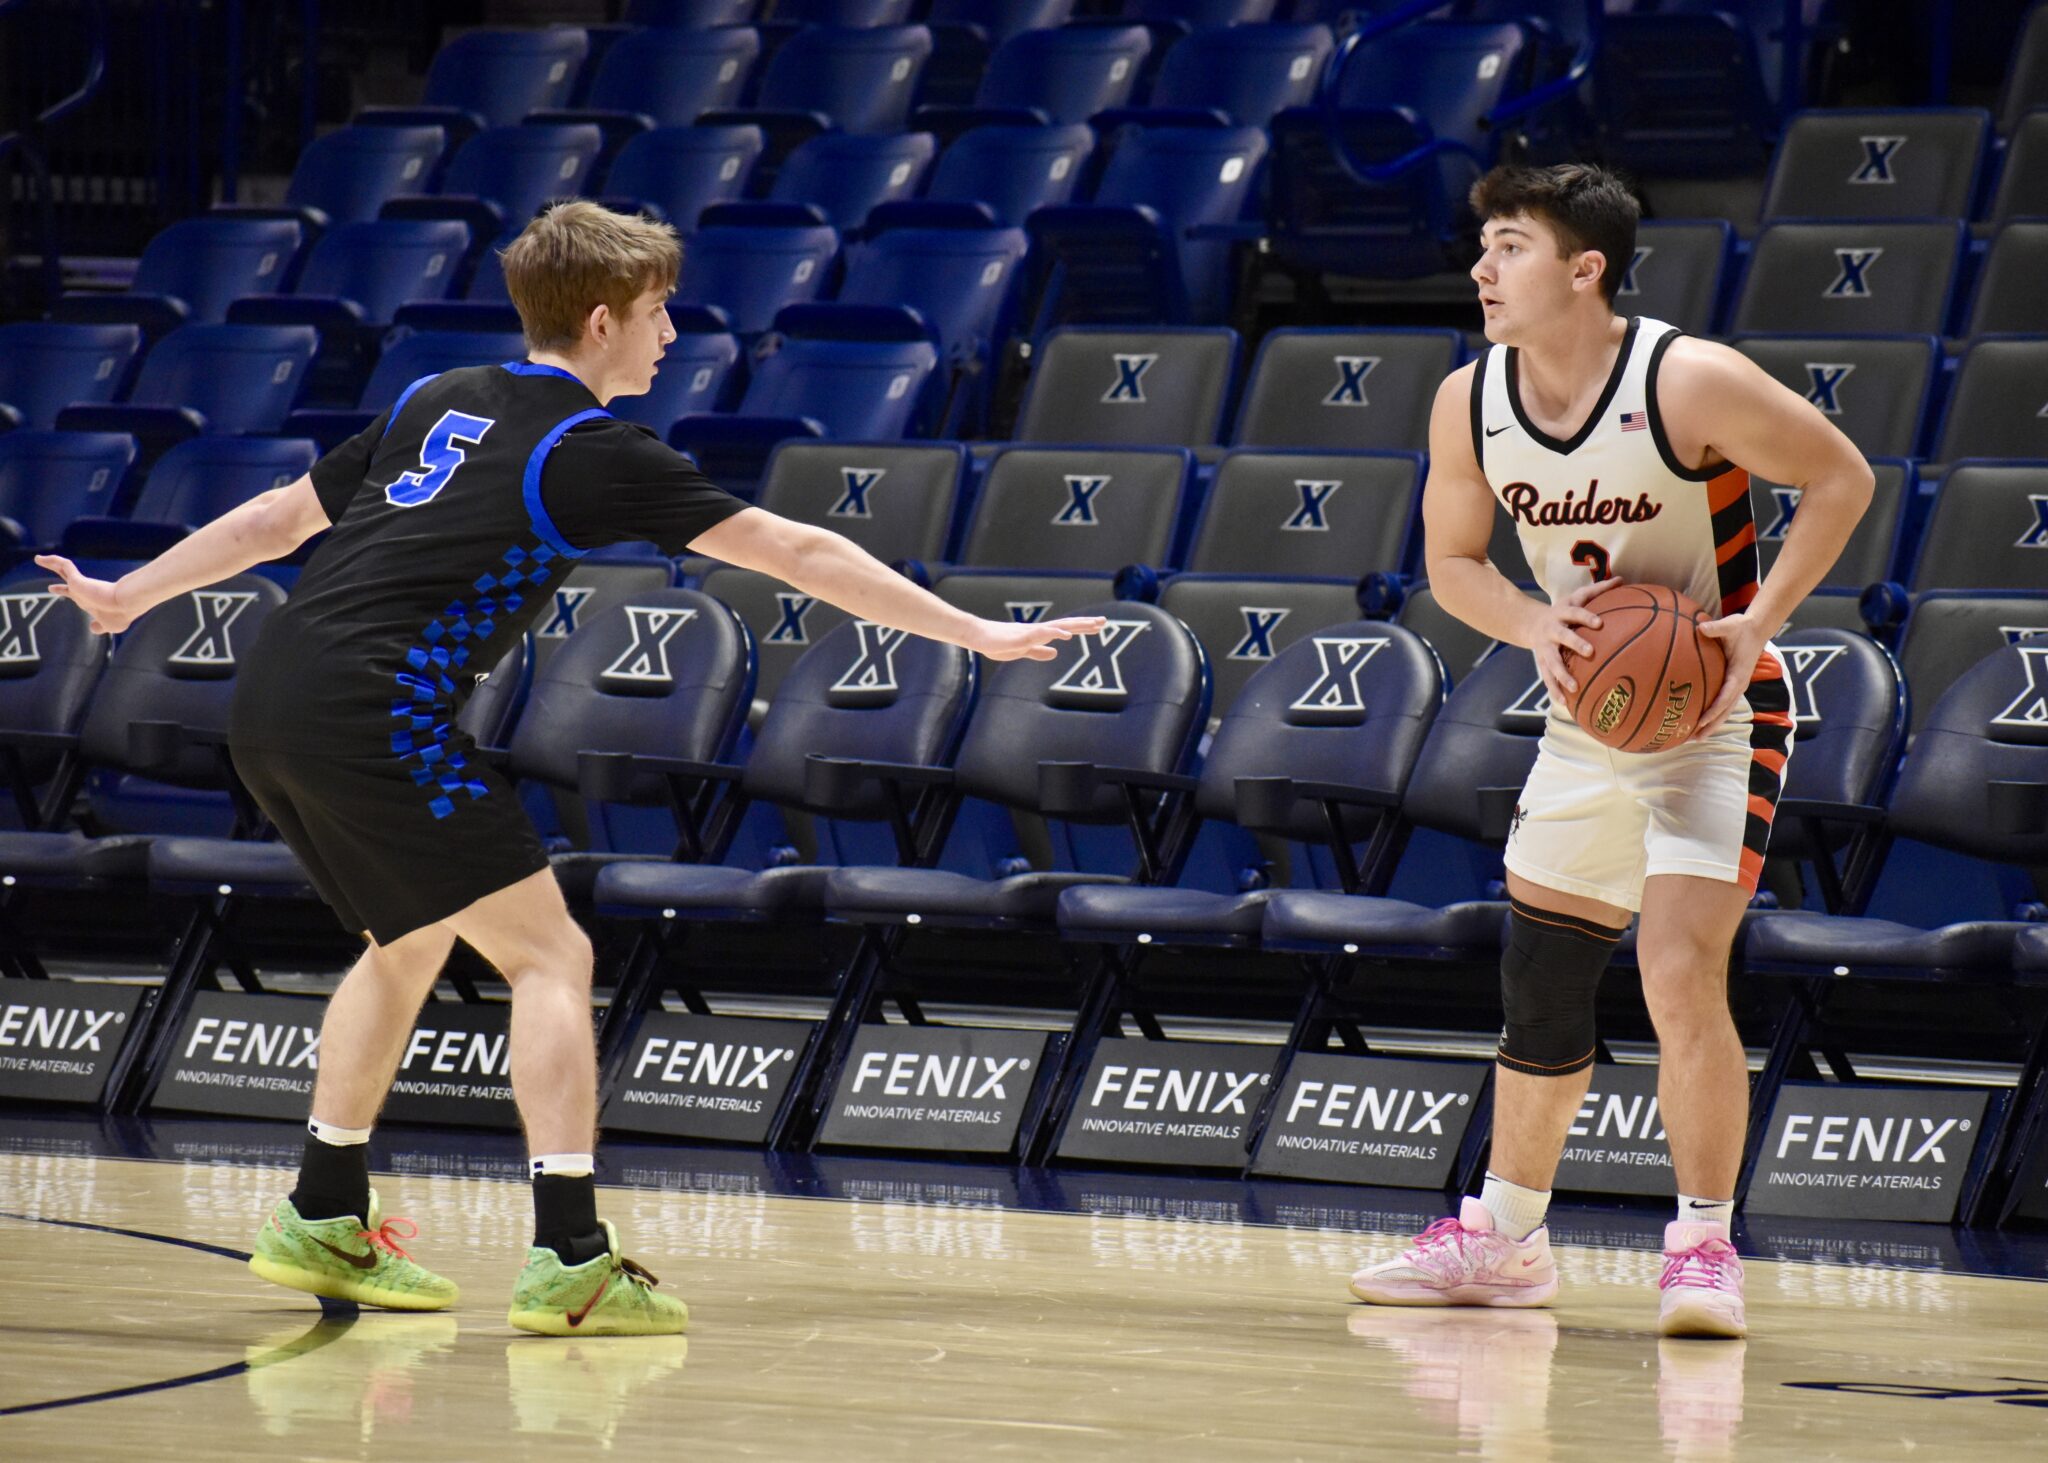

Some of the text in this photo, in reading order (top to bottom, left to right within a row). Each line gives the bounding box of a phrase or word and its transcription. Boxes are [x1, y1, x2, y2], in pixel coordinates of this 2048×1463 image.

[385, 409, 495, 508] 5
[1502, 479, 1662, 527] Raiders
[168, 591, 259, 664] X
[601, 606, 697, 681] X
[1290, 637, 1390, 710] X
[29, 1060, 95, 1075] MATERIALS
[175, 1069, 312, 1093] INNOVATIVE MATERIALS
[392, 1080, 514, 1100] INNOVATIVE MATER
[623, 1090, 762, 1113] INNOVATIVE MATERIALS
[843, 1104, 1002, 1124] INNOVATIVE MATERIALS
[1567, 1092, 1667, 1140] ENI
[1082, 1118, 1241, 1139] INNOVATIVE MATERIALS
[1276, 1135, 1438, 1160] INNOVATIVE MATERIALS
[1606, 1151, 1674, 1167] MATERIAL
[1769, 1171, 1942, 1190] INNOVATIVE MATERIALS
